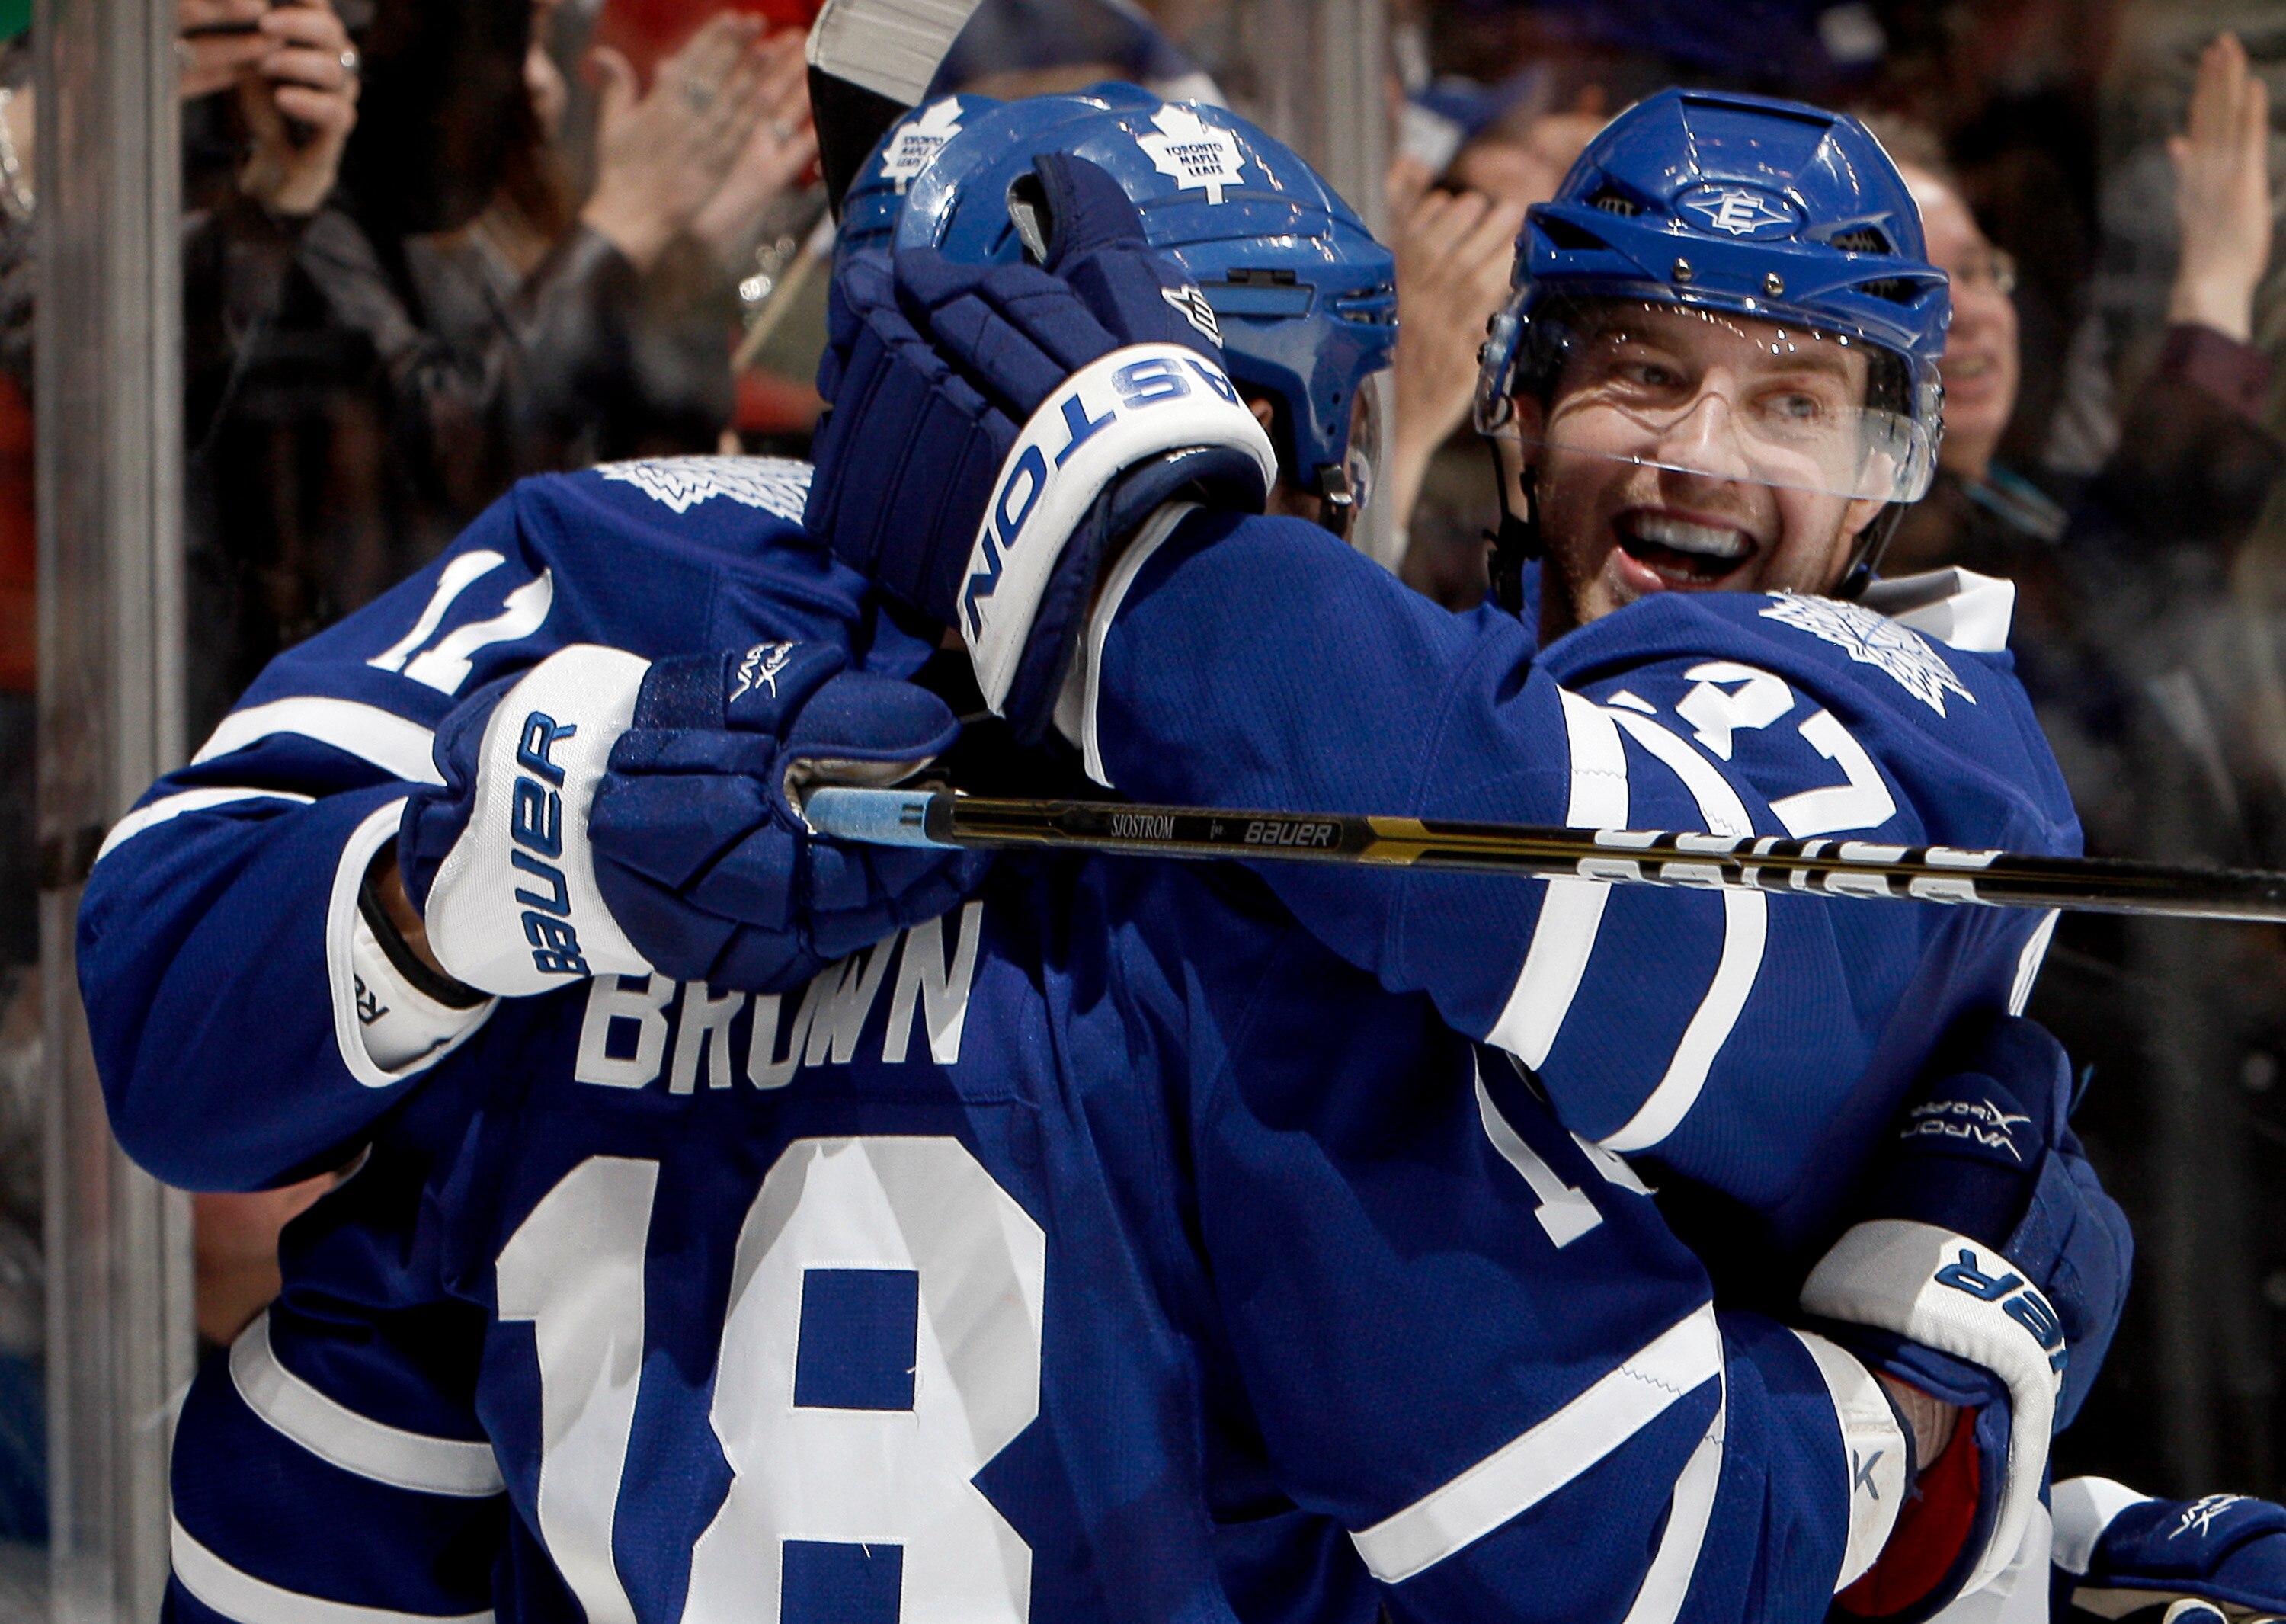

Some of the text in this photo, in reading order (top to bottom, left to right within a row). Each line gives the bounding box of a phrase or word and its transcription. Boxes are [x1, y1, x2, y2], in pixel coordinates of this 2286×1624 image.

[1164, 143, 1224, 156] TORONTO
[1180, 153, 1221, 165] MAPLE
[1188, 165, 1224, 177] LEAFS
[367, 549, 553, 696] 11
[1110, 813, 1174, 840] SJOSTROM
[1244, 821, 1333, 847] BAUER
[575, 899, 984, 1094] BROWN
[495, 1135, 1046, 1624] 18
